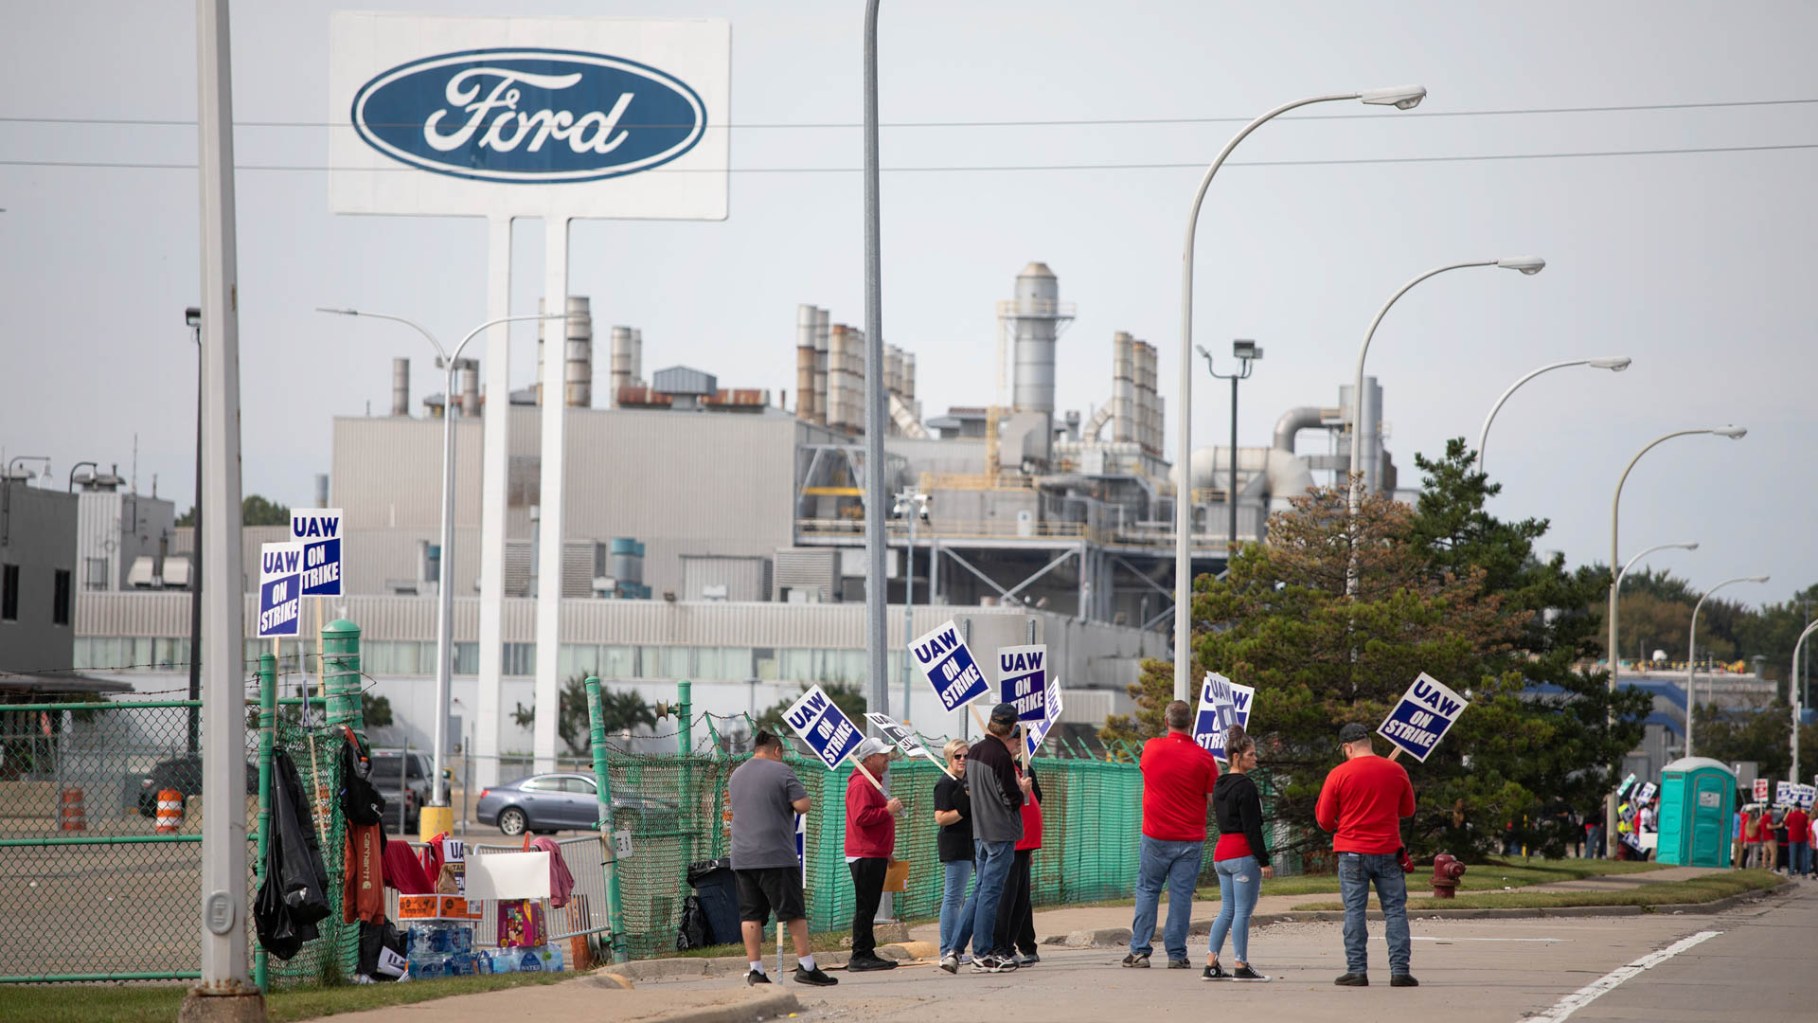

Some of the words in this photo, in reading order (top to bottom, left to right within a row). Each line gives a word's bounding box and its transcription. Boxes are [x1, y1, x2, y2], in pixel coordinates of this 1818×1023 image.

[423, 67, 634, 153] Ford
[293, 517, 339, 537] UAW
[263, 551, 300, 574] UAW
[307, 544, 325, 567] ON
[302, 561, 339, 589] TRIKE
[272, 581, 288, 605] ON
[261, 598, 298, 632] STRIKE
[914, 628, 958, 664] UAW
[941, 656, 961, 682] ON
[1001, 652, 1043, 672] UAW
[941, 663, 980, 708] STRIKE
[1015, 677, 1031, 697] ON
[1205, 685, 1249, 710] UW
[1210, 679, 1231, 703] UAW
[788, 691, 827, 729] UAW
[1010, 690, 1043, 716] TRIKE
[1413, 680, 1461, 717] UAW
[817, 717, 835, 740] ON
[1409, 710, 1435, 729] ON
[822, 719, 853, 764] STRIKE
[1196, 733, 1224, 750] STRI
[1385, 719, 1438, 748] STRIKE
[451, 842, 464, 859] UA
